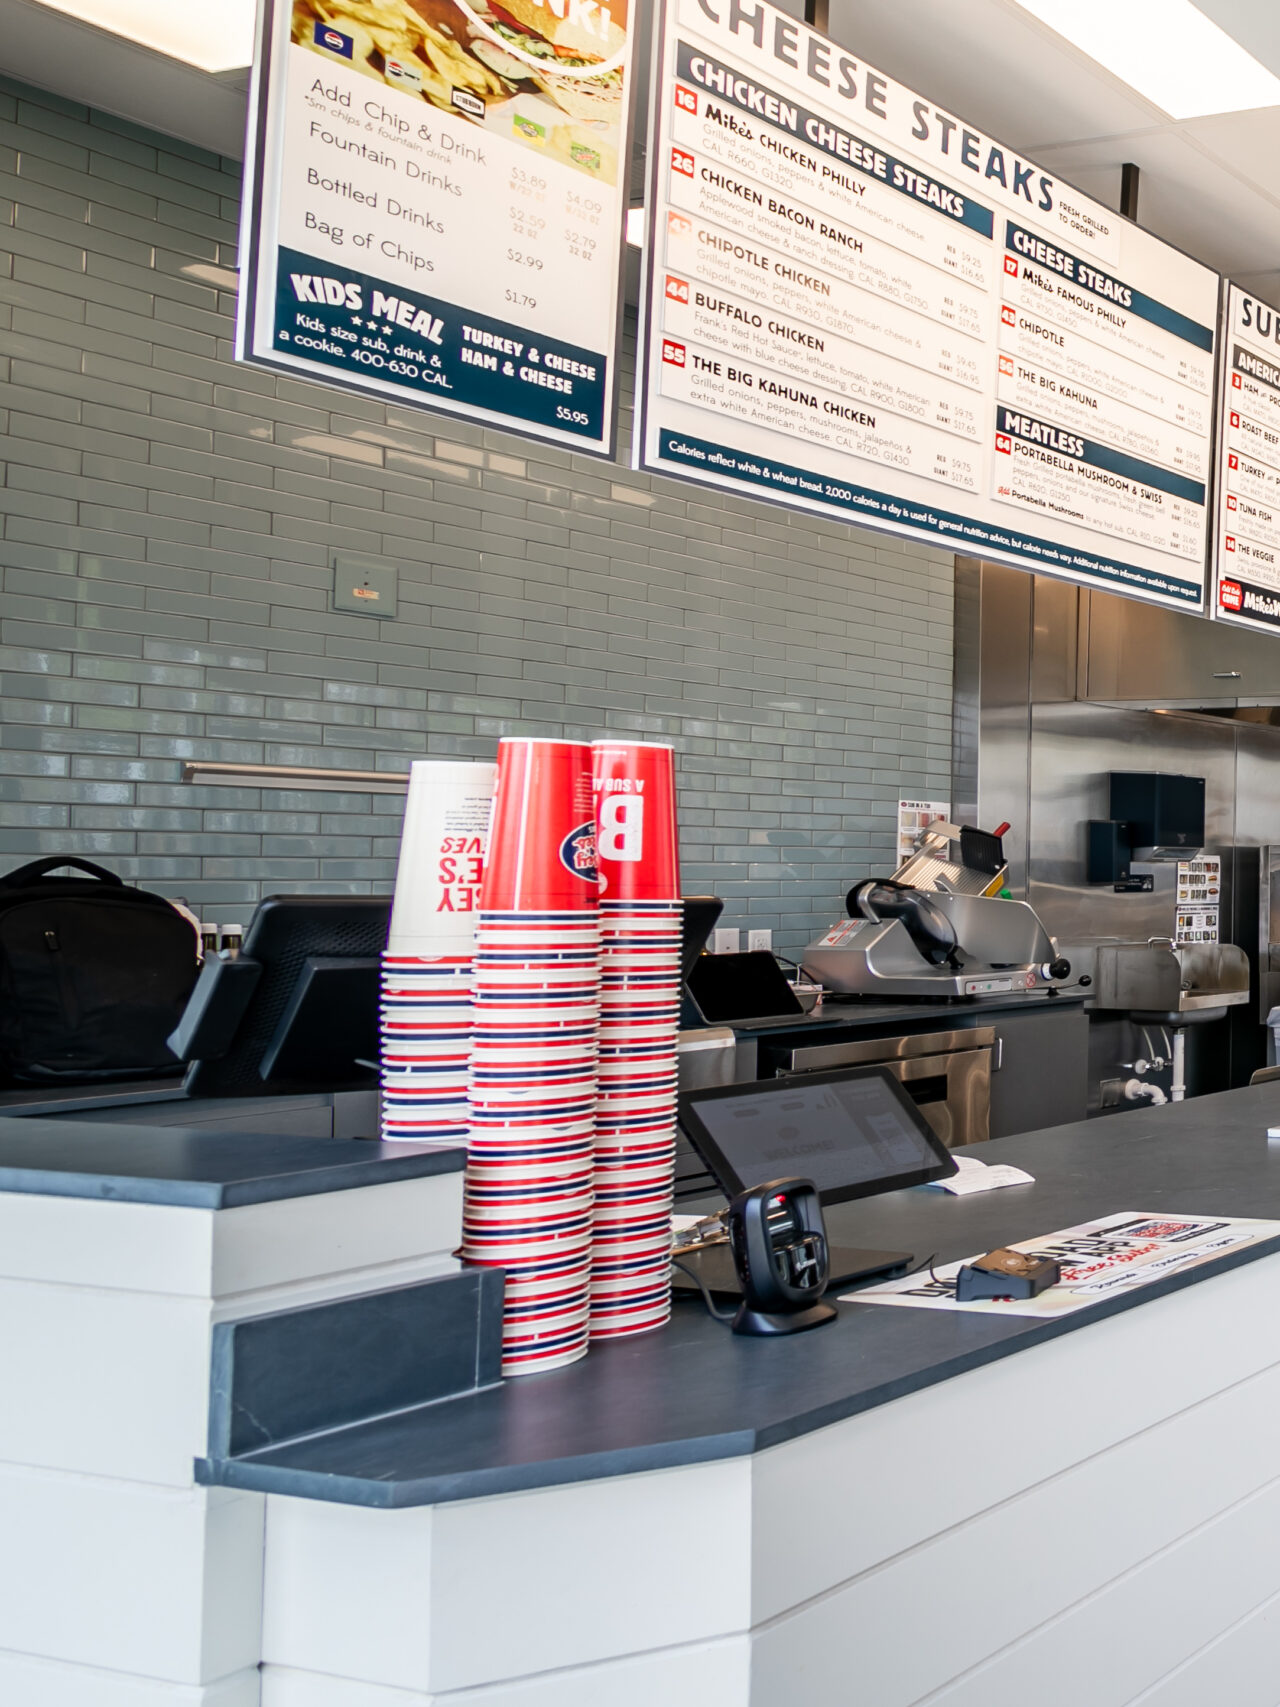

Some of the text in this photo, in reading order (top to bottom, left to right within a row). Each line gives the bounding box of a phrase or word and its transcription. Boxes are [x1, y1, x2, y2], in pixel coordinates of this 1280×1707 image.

[311, 79, 485, 164] Add Chip & Drink
[697, 0, 1053, 213] CHEESE STEAKS
[310, 121, 396, 170] Fountain
[406, 160, 462, 196] Drinks
[677, 90, 866, 196] 16 Mike's CHICKEN PHILLY
[689, 56, 964, 219] CHICKEN CHEESE STEAKS
[307, 167, 444, 233] Bottled Drinks
[672, 154, 863, 253] 26 CHICKEN BACON RANCH
[1059, 201, 1109, 235] FRESH GRILLED
[305, 211, 434, 272] Bag of Chips
[1059, 214, 1094, 237] TO ORDER!
[507, 248, 543, 271] $2.99
[698, 231, 830, 296] CHIPOTLE CHICKEN
[1013, 230, 1133, 308] CHEESE STEAKS
[290, 272, 445, 346] KIDS MEAL
[505, 289, 537, 309] $1.79
[667, 281, 824, 352] 44 BUFFALO CHICKEN
[1005, 260, 1126, 328] 17 Mike's FAMOUS PHILLY
[296, 313, 441, 368] Kids size sub, drink &
[462, 324, 597, 382] TURKEY & CHEESE
[1019, 318, 1064, 347] CHIPOTLE
[279, 330, 453, 389] a cookie. 400-630 CAL.
[461, 346, 573, 395] HAM & CHEESE
[664, 344, 875, 428] 55 THE BIG KAHUNA CHICKEN
[1018, 367, 1097, 409] THE BIG KAHUNA
[1244, 383, 1259, 396] HAM
[556, 406, 589, 425] $5.95
[690, 391, 716, 405] extra
[720, 400, 747, 415] white
[751, 408, 795, 430] American
[1004, 410, 1085, 458] MEATLESS
[1242, 420, 1262, 436] ROAST
[1264, 431, 1279, 444] BEEF
[669, 441, 880, 509] Calories reflect white & wheat bread. 2,000 calories
[1014, 442, 1162, 504] PORTABELLA MUSHROOM & SWISS
[1241, 462, 1265, 479] TURKEY
[1012, 490, 1046, 507] Portabella
[1048, 502, 1084, 520] Mushrooms
[1239, 502, 1272, 522] TUNA FISH
[1238, 543, 1274, 563] THE VEGGIE
[607, 779, 630, 793] SUB
[635, 779, 644, 793] A
[440, 837, 483, 854] VES
[595, 794, 644, 862] B
[439, 857, 483, 884] E'S
[436, 887, 482, 912] EY
[1086, 1241, 1135, 1260] APP
